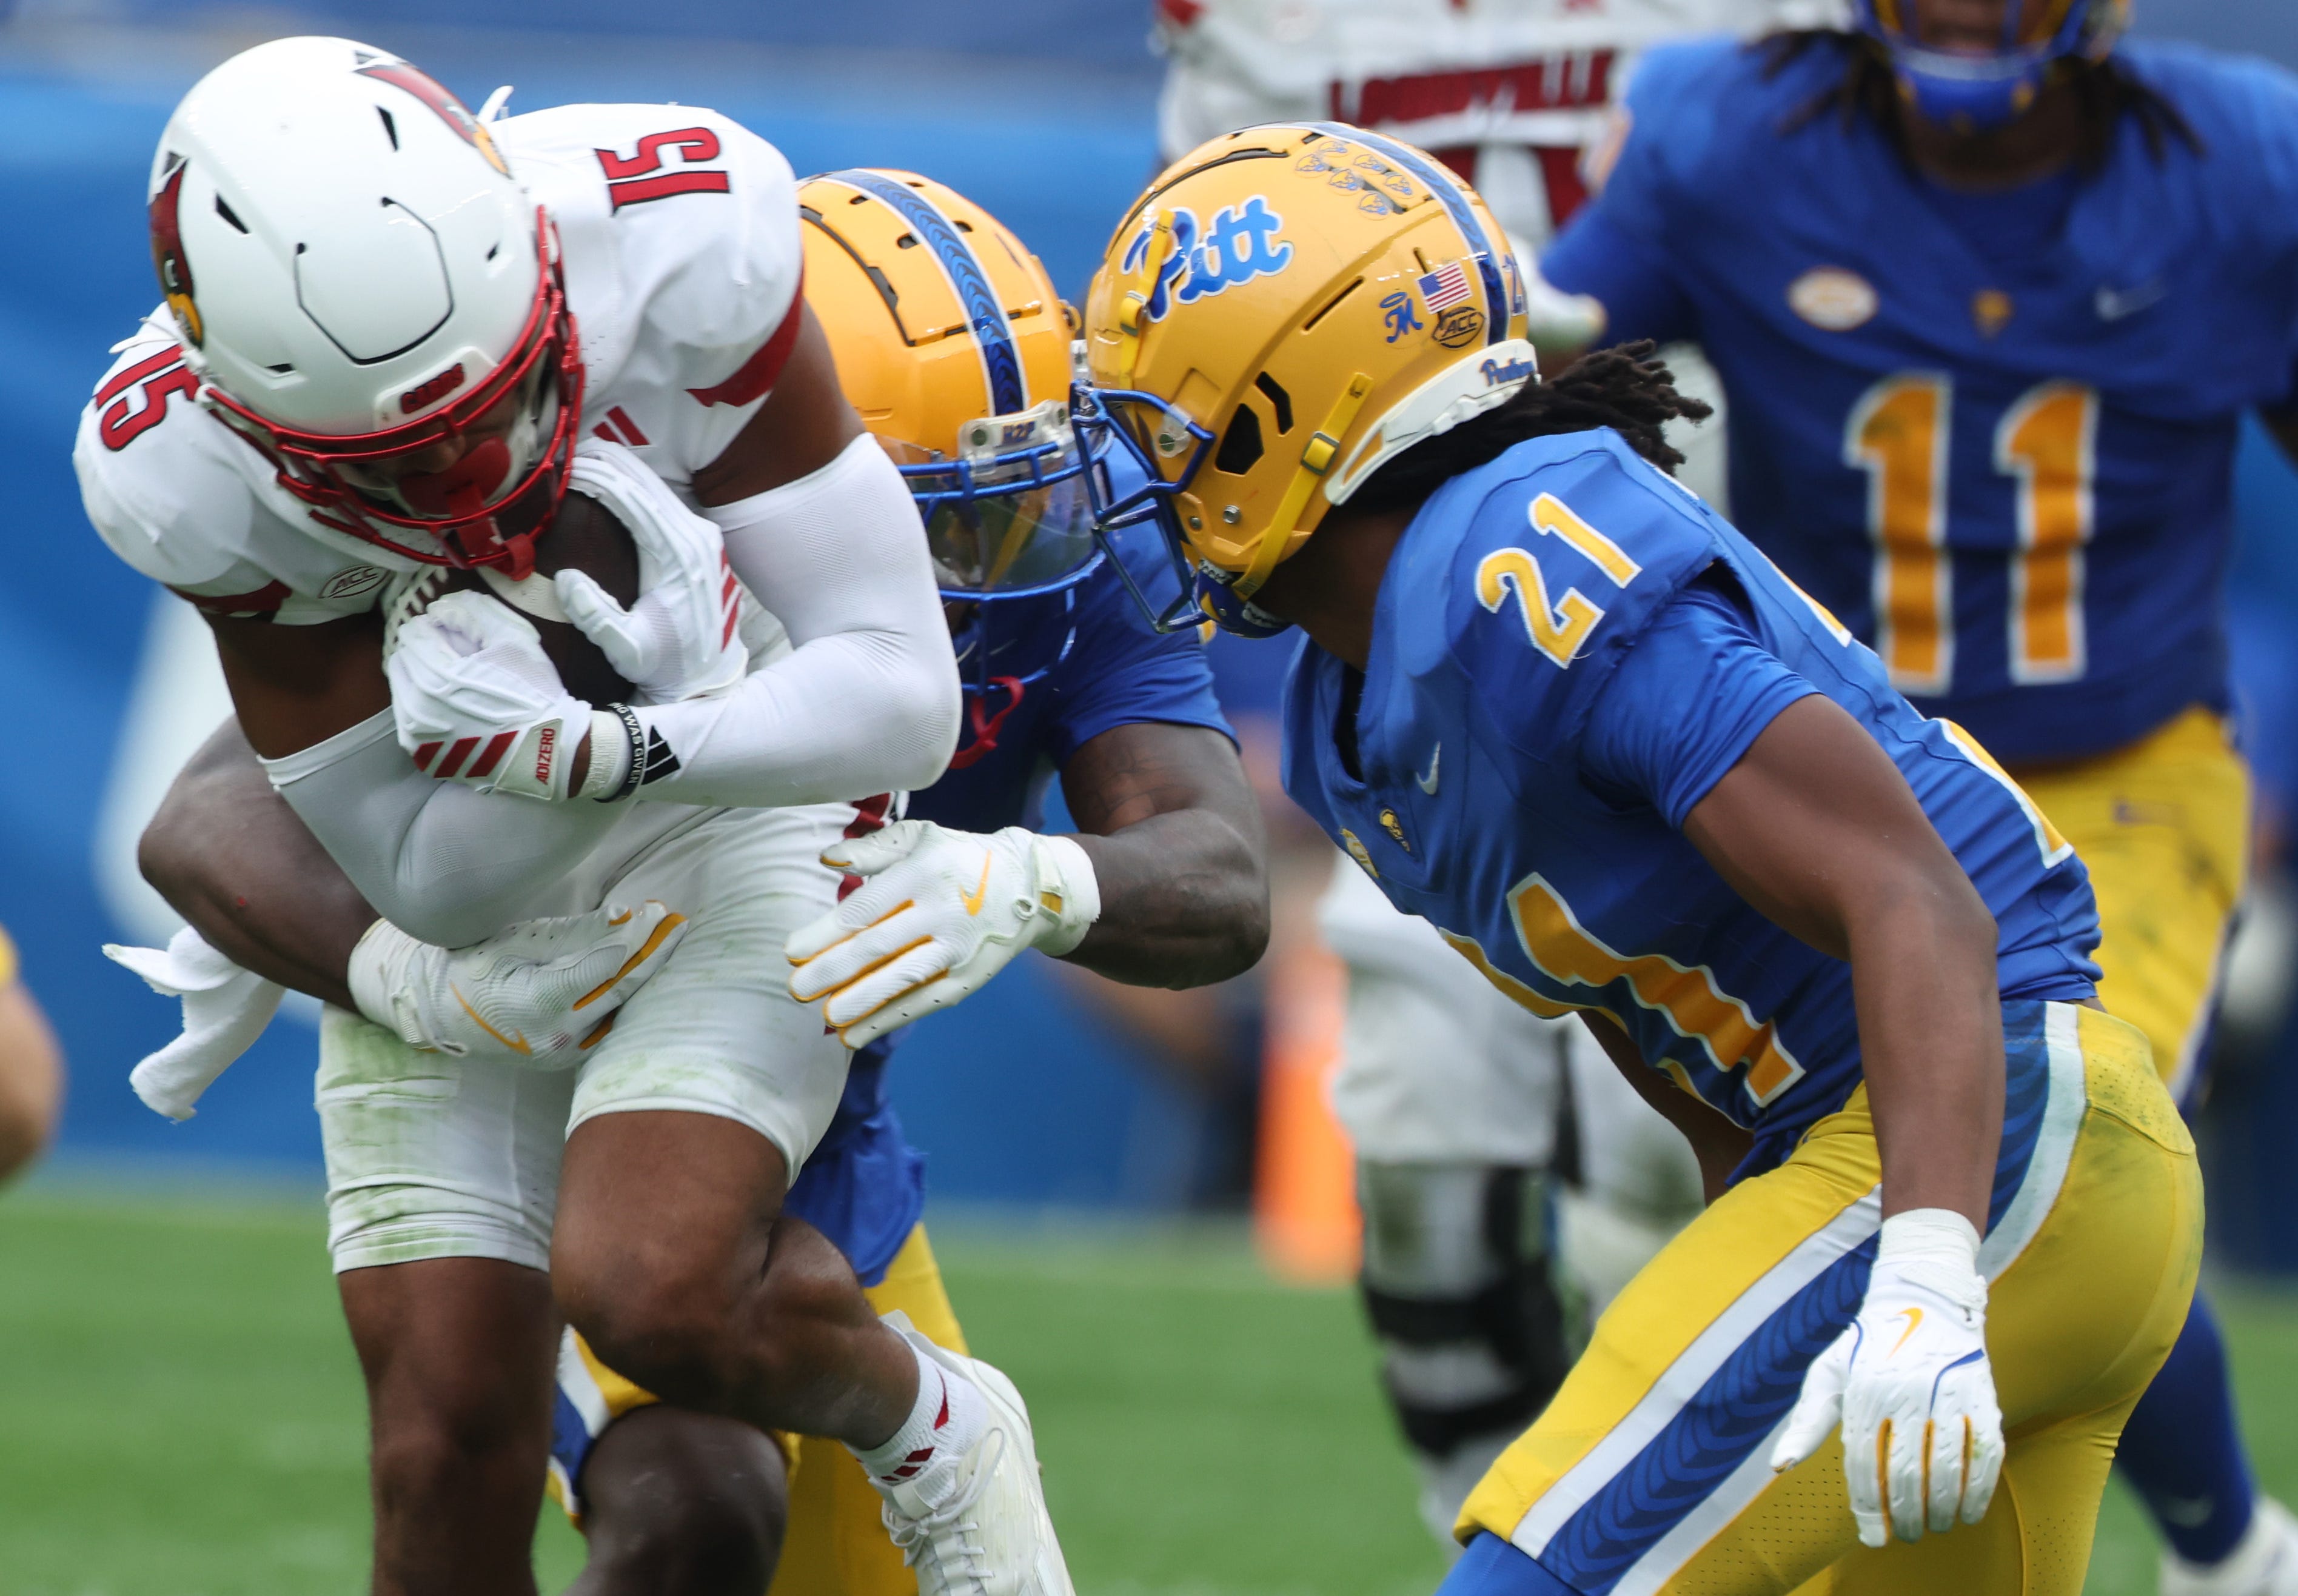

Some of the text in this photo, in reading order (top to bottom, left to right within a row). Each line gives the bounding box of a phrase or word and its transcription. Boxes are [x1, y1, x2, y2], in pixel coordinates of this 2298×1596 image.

[593, 127, 733, 216] 15
[1121, 194, 1296, 323] Pitt
[94, 342, 201, 452] 15
[330, 566, 380, 593] ACC
[1474, 492, 1643, 670] 21
[1841, 369, 2100, 699] 11
[535, 728, 556, 786] ADIZERO
[623, 715, 643, 745] WAS
[628, 747, 644, 784] GIVEN
[1438, 871, 1807, 1132] 1
